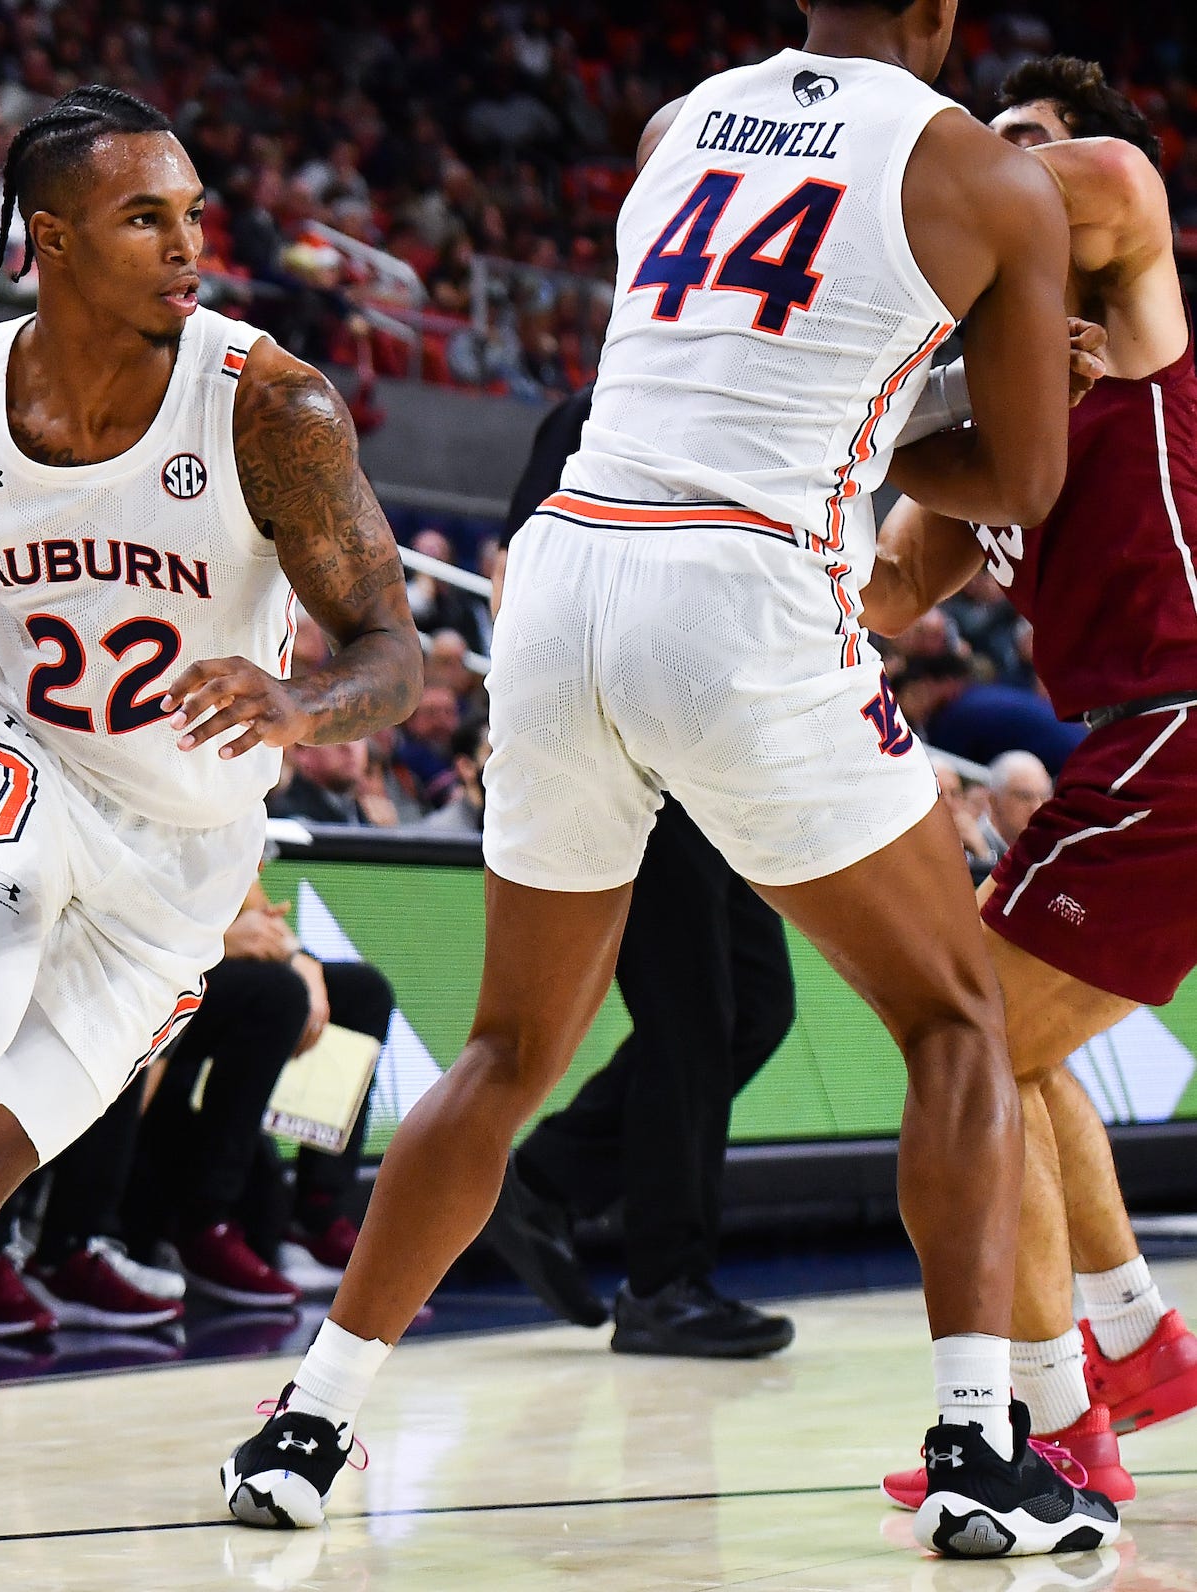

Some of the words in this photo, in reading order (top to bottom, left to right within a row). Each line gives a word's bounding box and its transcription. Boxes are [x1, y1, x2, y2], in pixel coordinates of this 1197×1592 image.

[696, 110, 845, 160] CARDWELL
[627, 168, 848, 337] 44
[164, 455, 205, 497] SEC
[25, 612, 183, 735] 22
